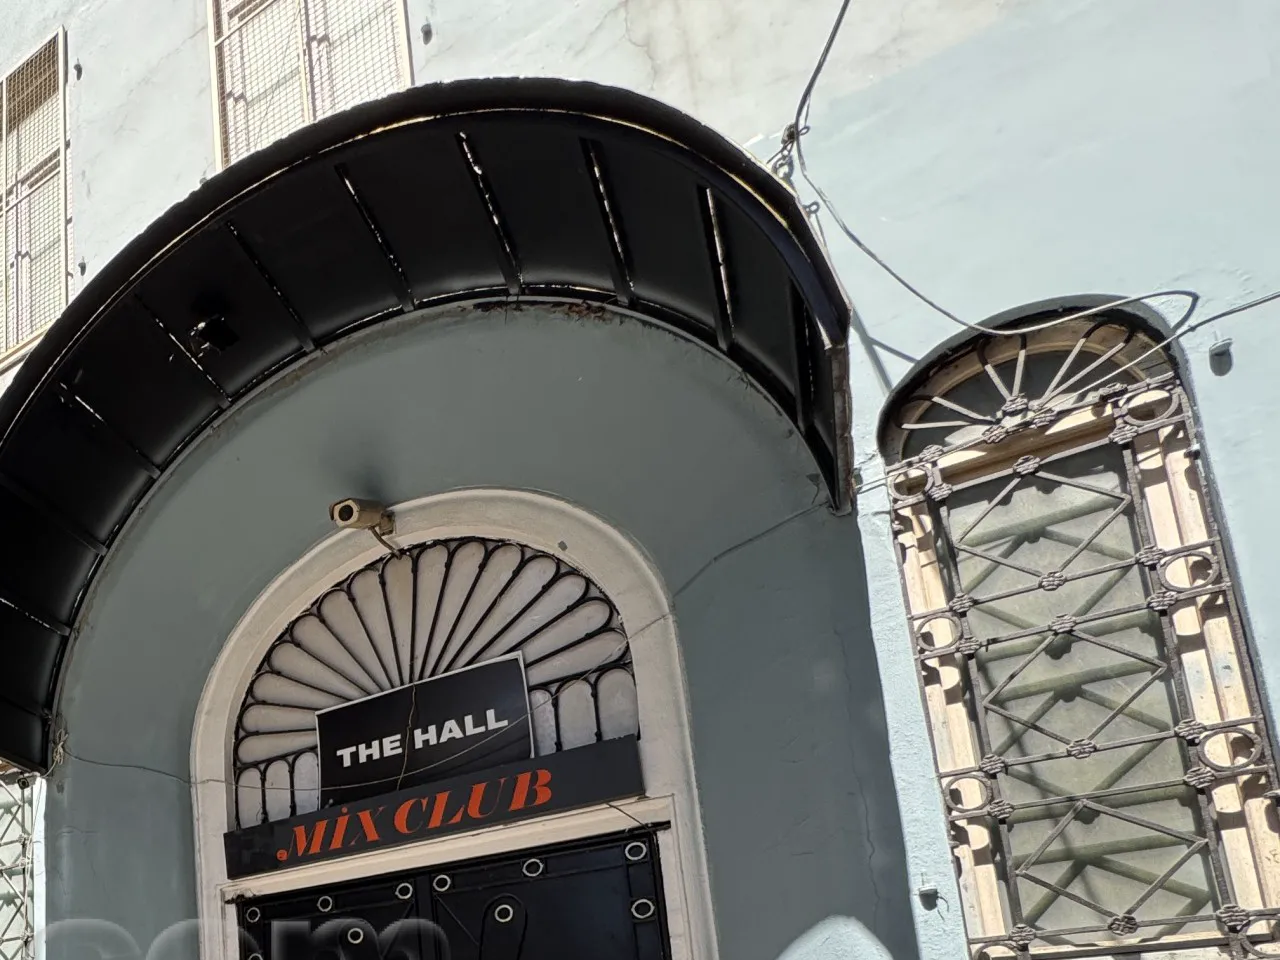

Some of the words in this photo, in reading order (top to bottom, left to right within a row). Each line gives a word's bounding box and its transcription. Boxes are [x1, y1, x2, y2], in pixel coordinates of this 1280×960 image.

[336, 734, 403, 768] THE
[413, 708, 509, 750] HALL
[393, 768, 552, 834] CLUB
